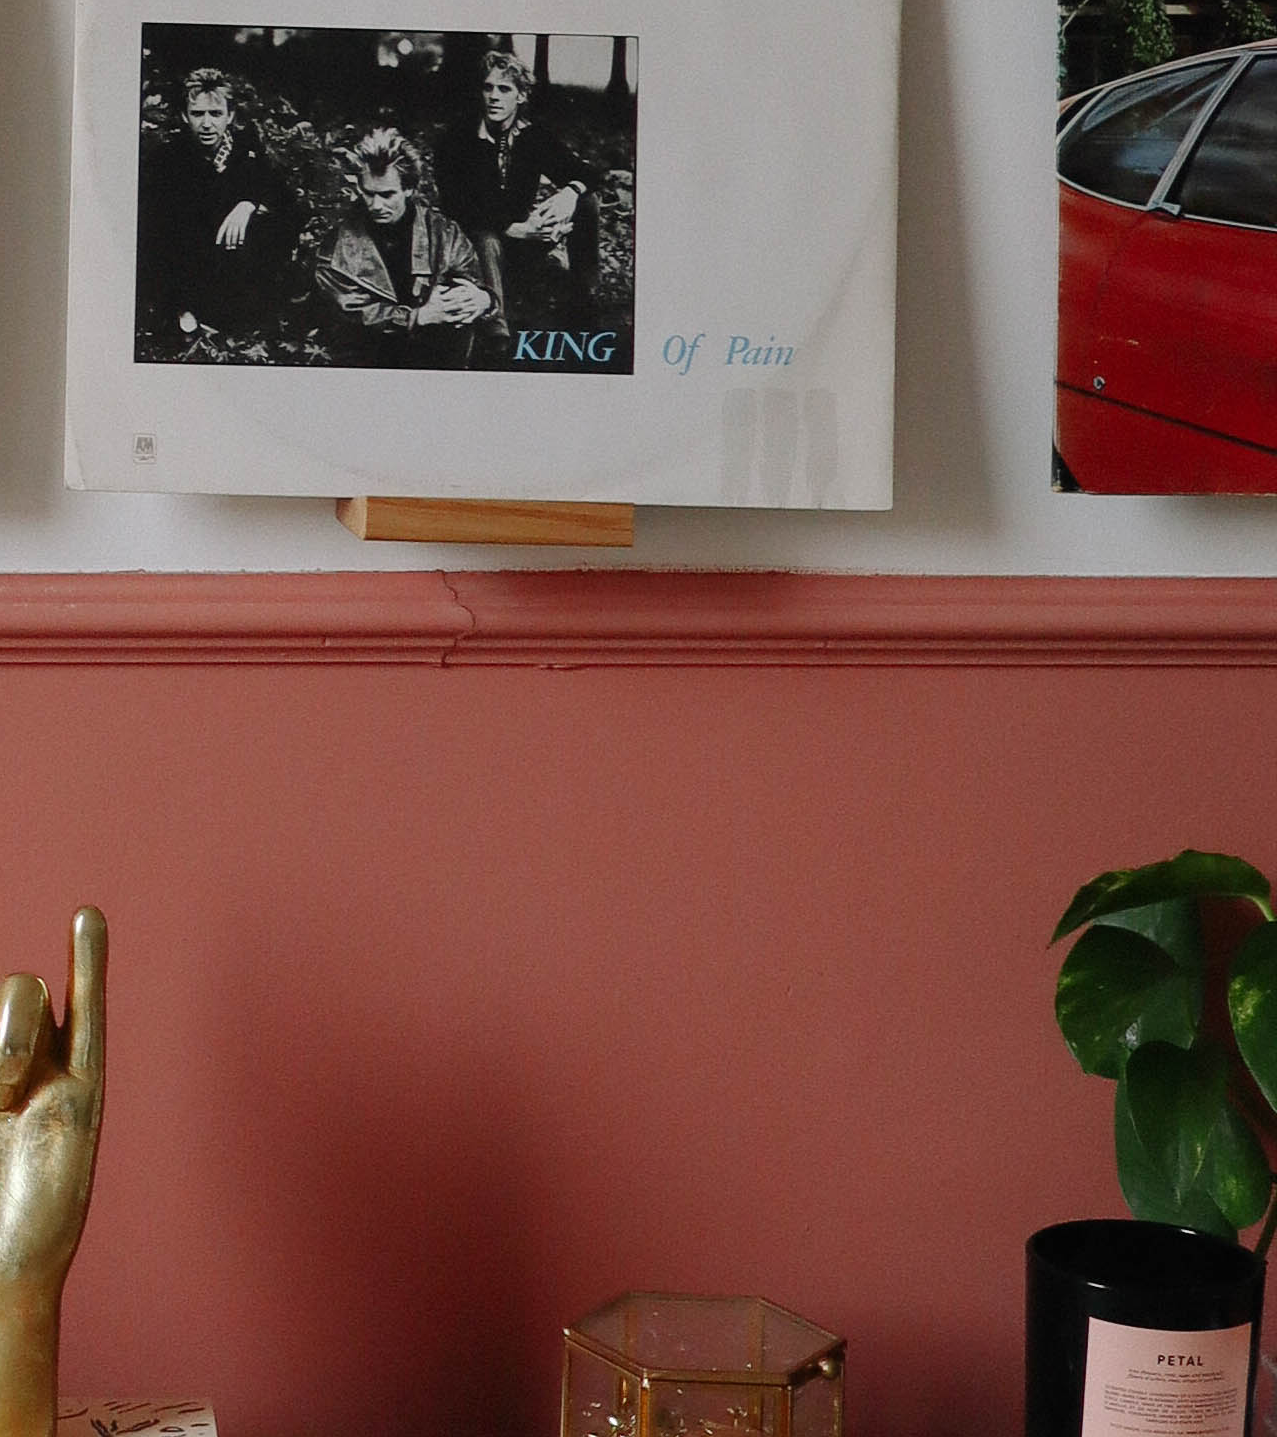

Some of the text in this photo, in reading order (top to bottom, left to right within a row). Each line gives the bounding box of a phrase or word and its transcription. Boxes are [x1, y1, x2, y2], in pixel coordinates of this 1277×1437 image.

[512, 329, 797, 375] KING Of Pain
[1157, 1354, 1204, 1366] PETAL
